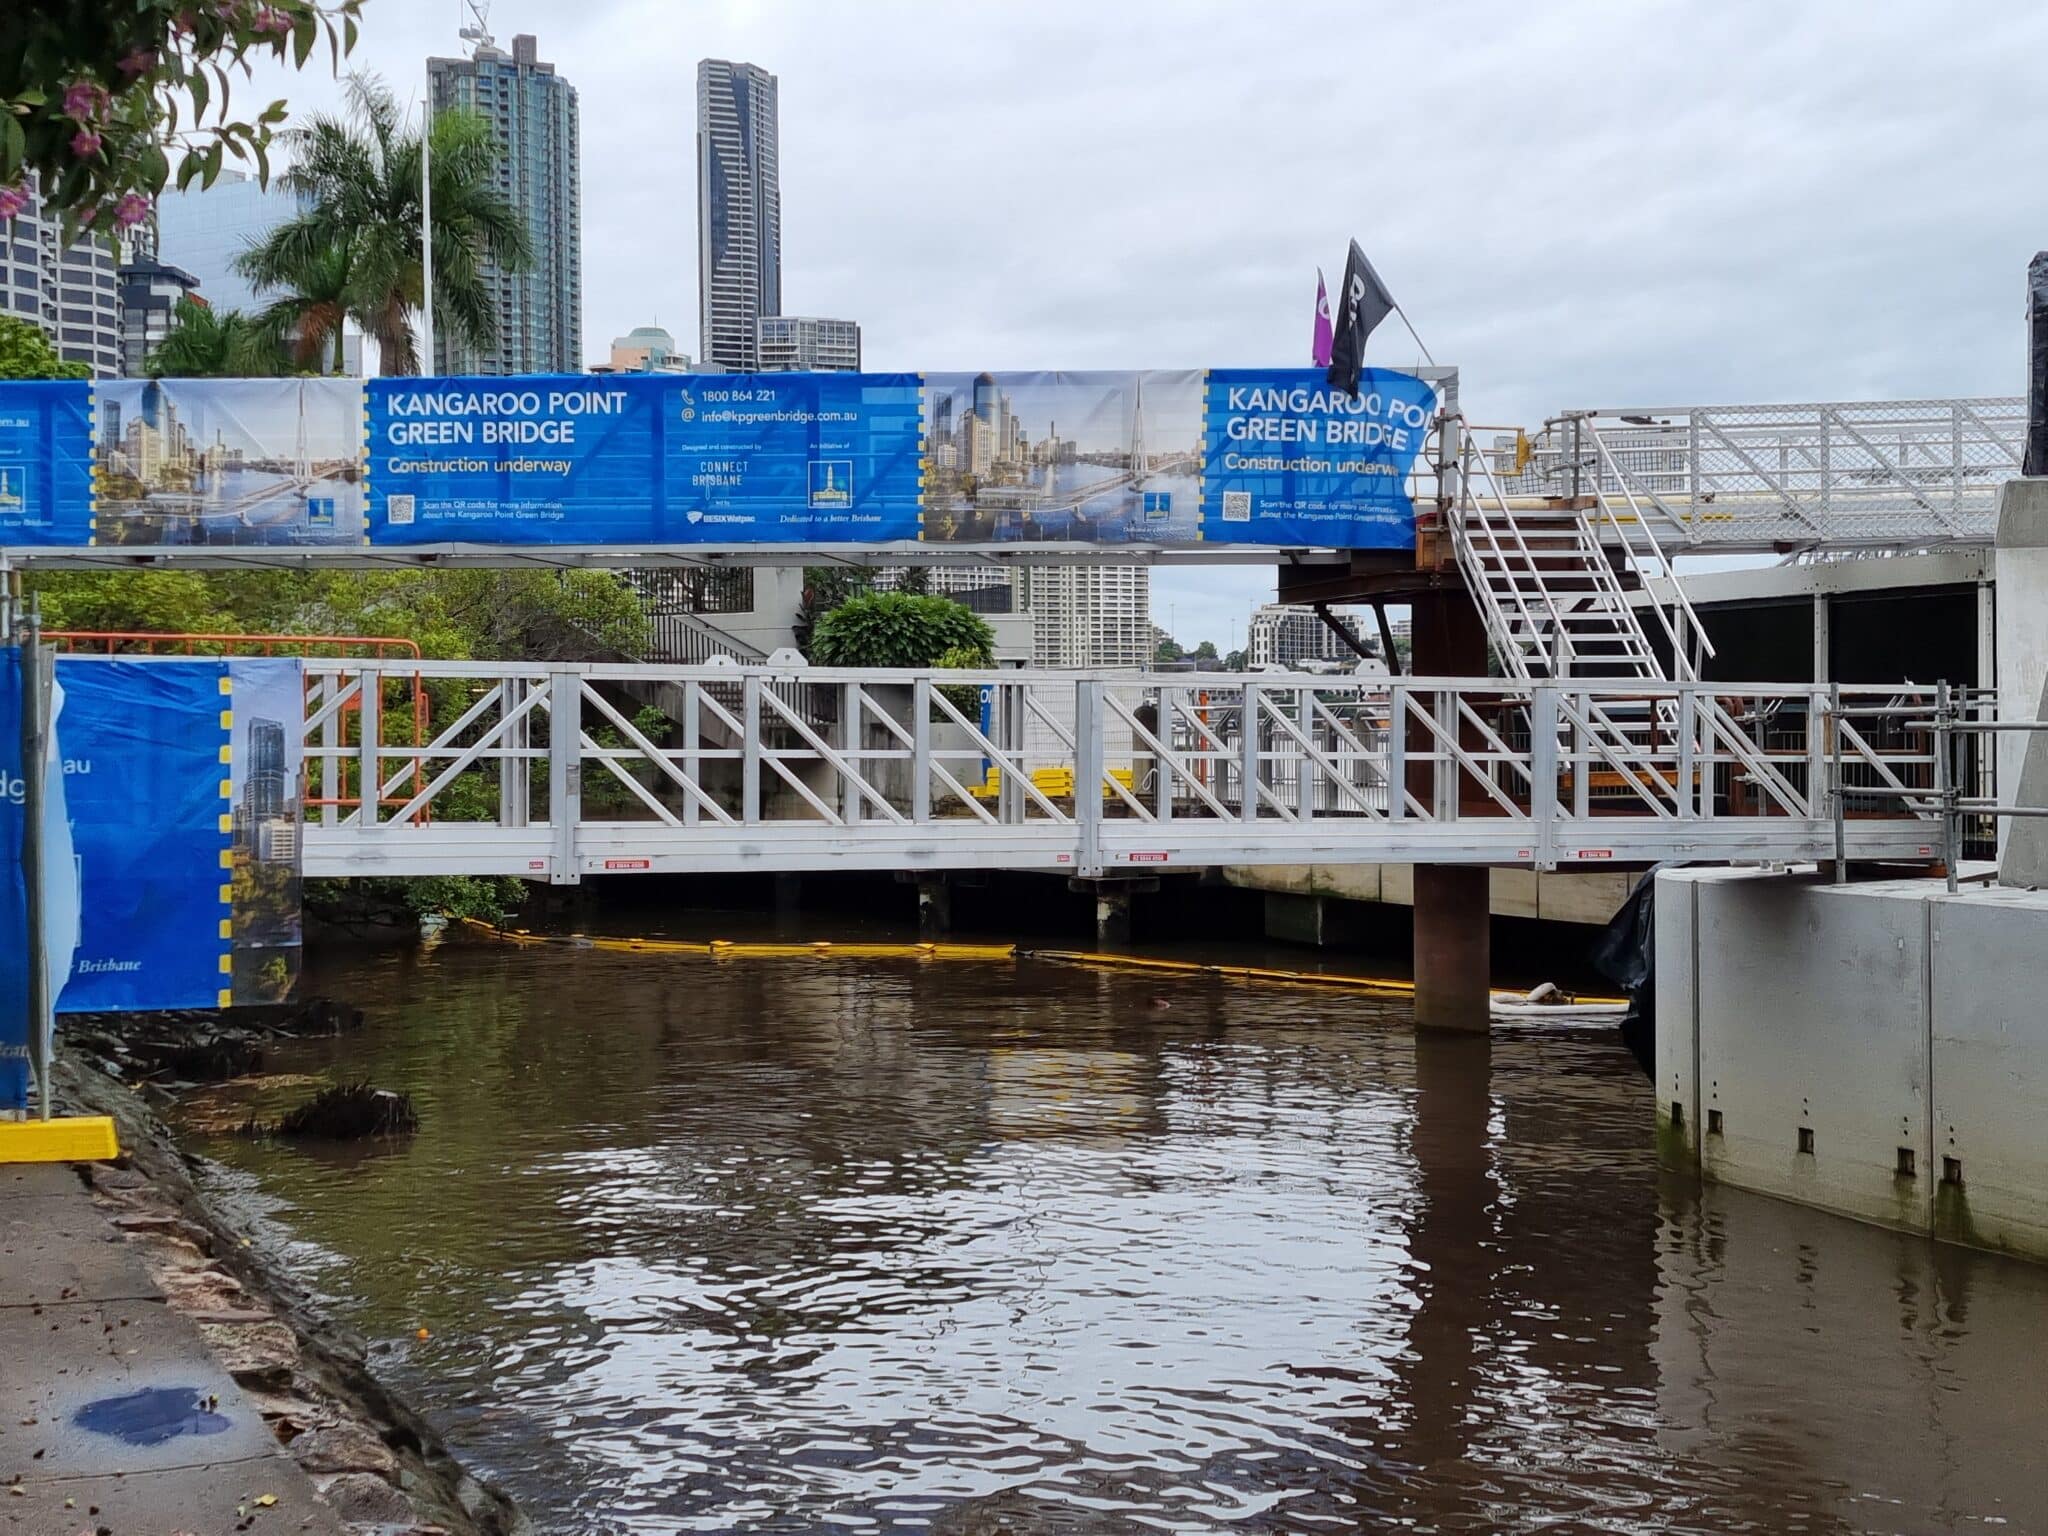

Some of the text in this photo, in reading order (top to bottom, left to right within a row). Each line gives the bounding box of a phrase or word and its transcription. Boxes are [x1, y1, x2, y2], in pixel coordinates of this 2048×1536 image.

[387, 391, 627, 416] KANGAROO POINT
[702, 389, 776, 402] 1800 864 221
[701, 410, 858, 425] info@kpgreenbridge.com.au
[1228, 387, 1434, 432] KANGAROO POI
[387, 420, 575, 445] GREEN BRIDGE
[1226, 417, 1409, 451] GREEN BRIDGE
[387, 456, 572, 476] Construction underway
[700, 461, 749, 473] CONNECT
[1224, 452, 1399, 477] Construction underw
[692, 474, 743, 486] BRISBANE
[457, 510, 493, 520] Kangaroo
[494, 510, 514, 519] Point
[515, 510, 539, 519] Green
[540, 510, 564, 520] Bridge
[1297, 511, 1334, 521] Kangaroo
[78, 957, 142, 973] Brisbane
